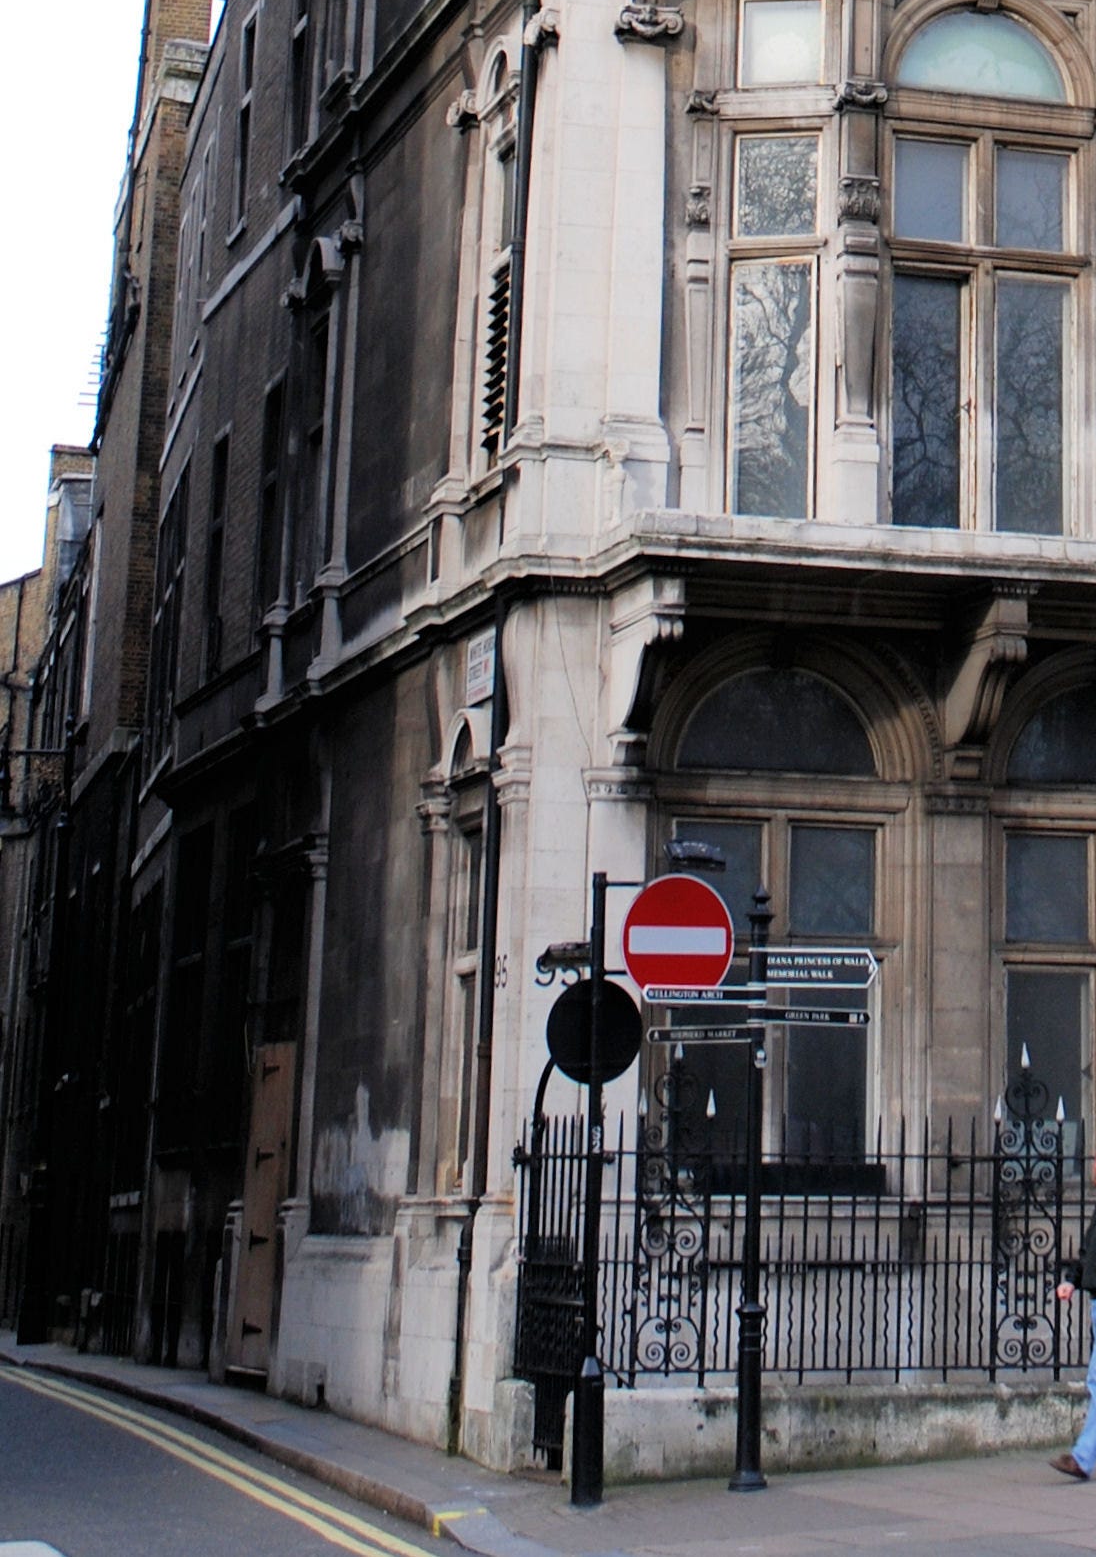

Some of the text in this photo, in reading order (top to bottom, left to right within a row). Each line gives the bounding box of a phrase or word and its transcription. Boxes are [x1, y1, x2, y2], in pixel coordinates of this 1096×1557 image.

[767, 956, 869, 965] DIANA PRINCESS OF WALES
[494, 953, 507, 988] 95
[767, 969, 833, 979] MEMORIAL WALK
[648, 989, 723, 999] WELLINGTON ARCH
[785, 1012, 830, 1021] GREEN PARK
[707, 1029, 737, 1038] MARKET
